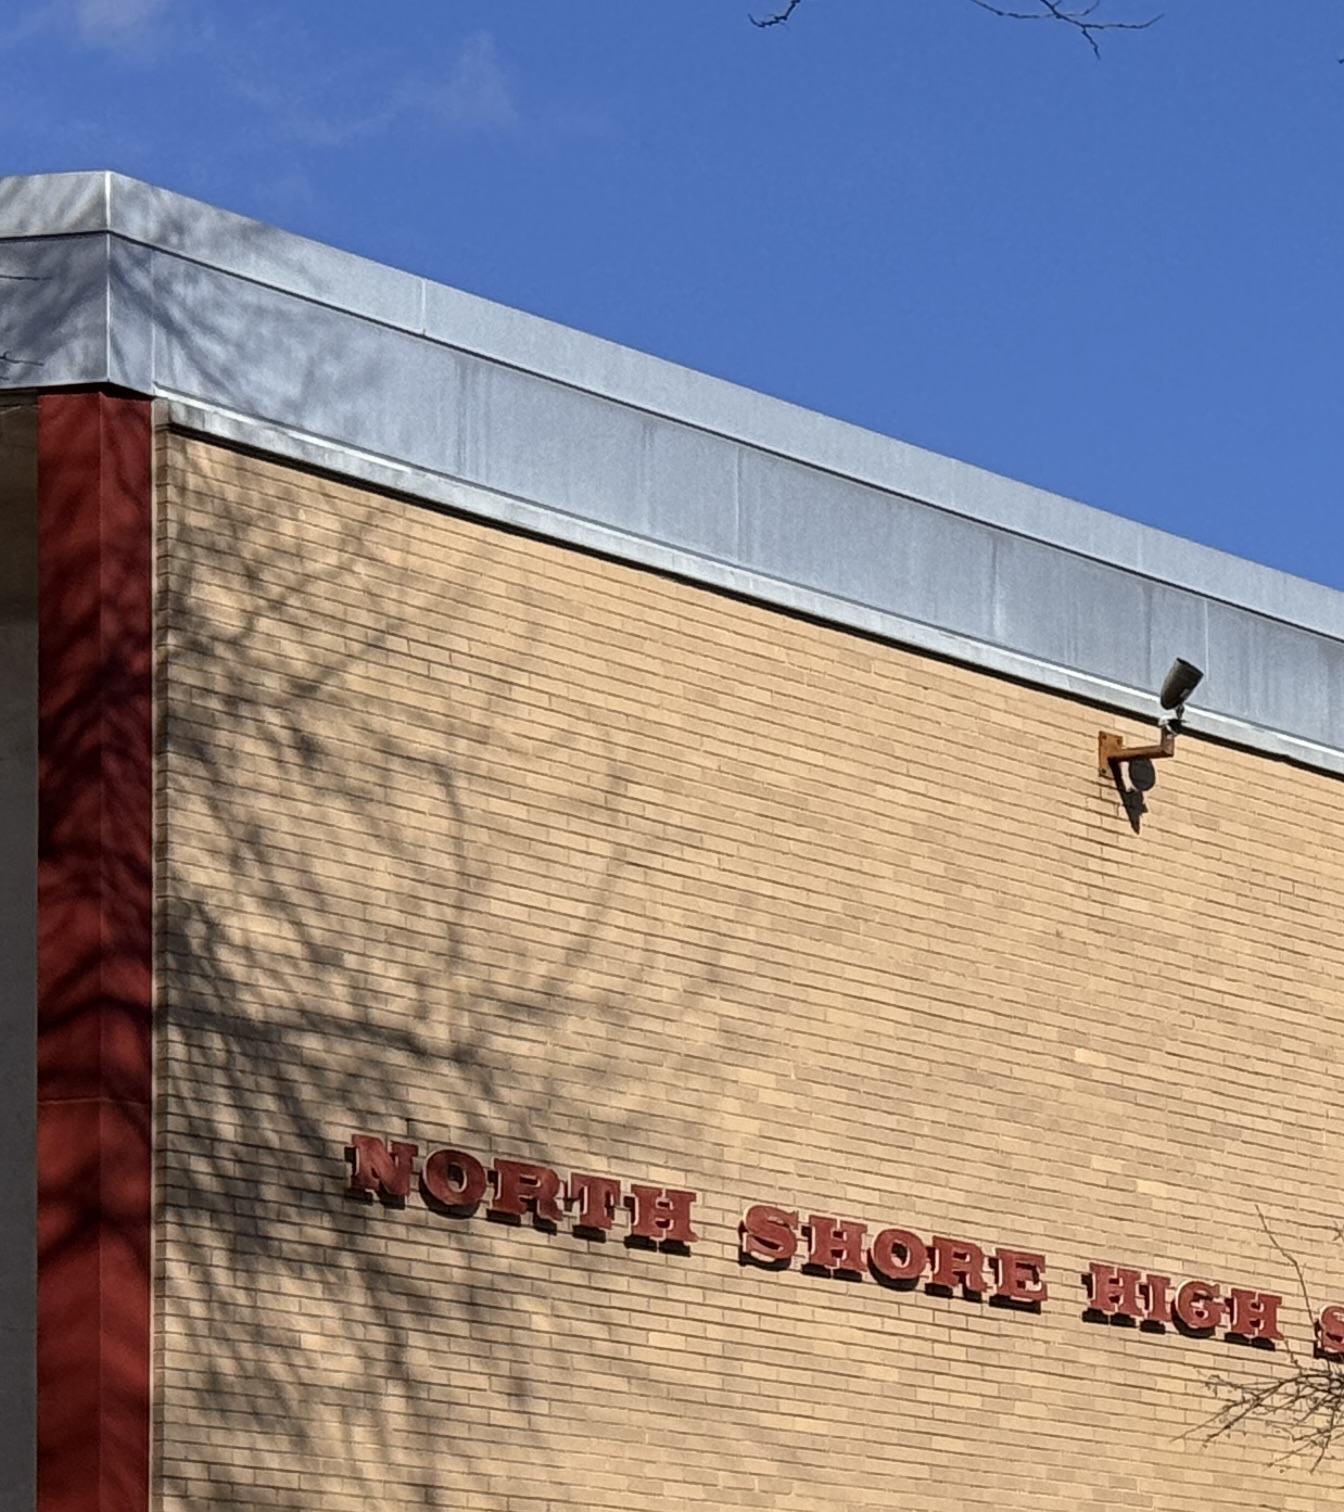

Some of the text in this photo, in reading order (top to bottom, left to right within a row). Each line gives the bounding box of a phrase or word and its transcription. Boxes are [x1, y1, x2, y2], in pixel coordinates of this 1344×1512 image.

[349, 1133, 699, 1245] NORTH
[743, 1203, 1048, 1302] SHORE
[1086, 1261, 1284, 1341] HIGH
